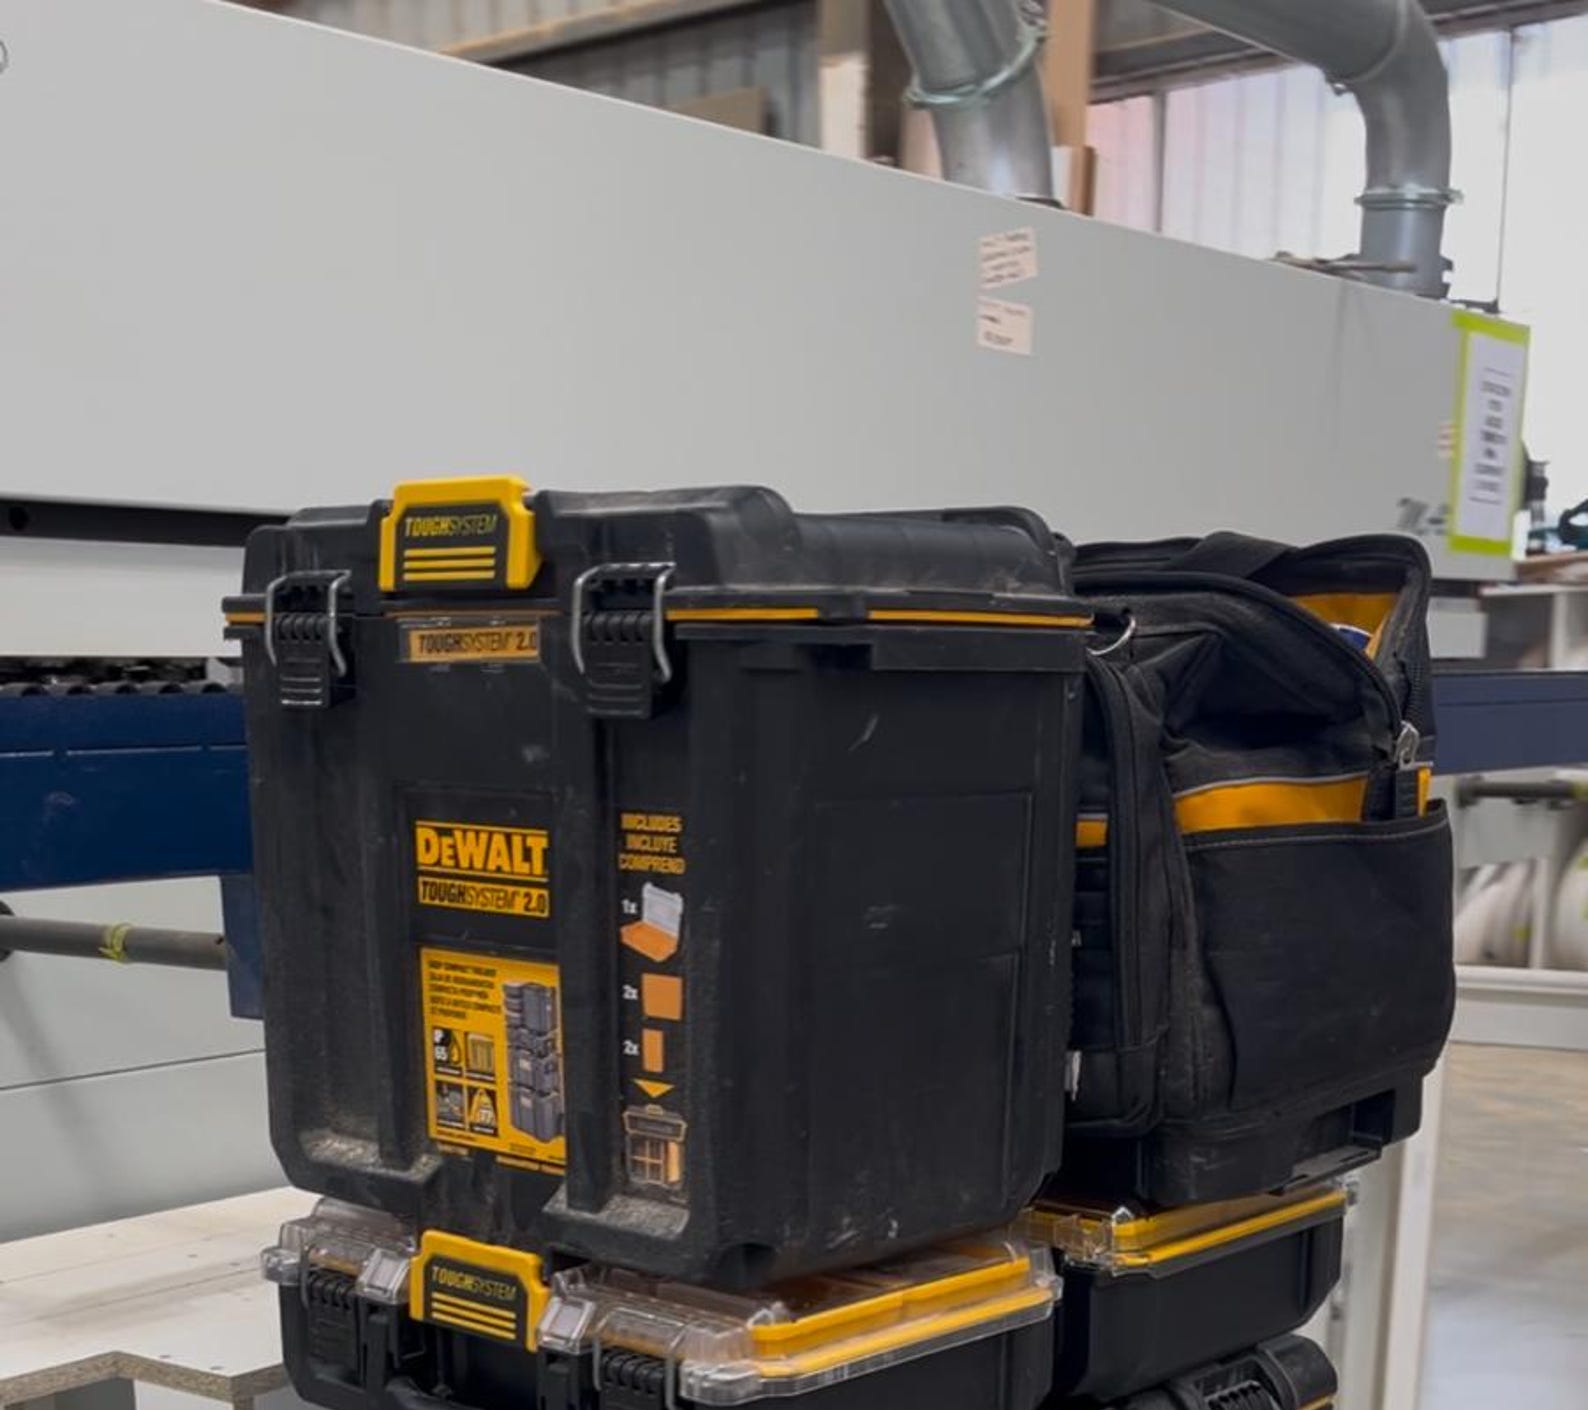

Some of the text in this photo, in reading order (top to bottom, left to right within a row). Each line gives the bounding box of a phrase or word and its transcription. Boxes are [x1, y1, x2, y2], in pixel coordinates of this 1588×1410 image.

[404, 514, 498, 536] TOUGHSYSTEM
[523, 891, 547, 914] 2.0
[622, 984, 639, 1000] 2x
[622, 1039, 640, 1055] 2x
[431, 1266, 517, 1300] TOUGHSYSTEM
